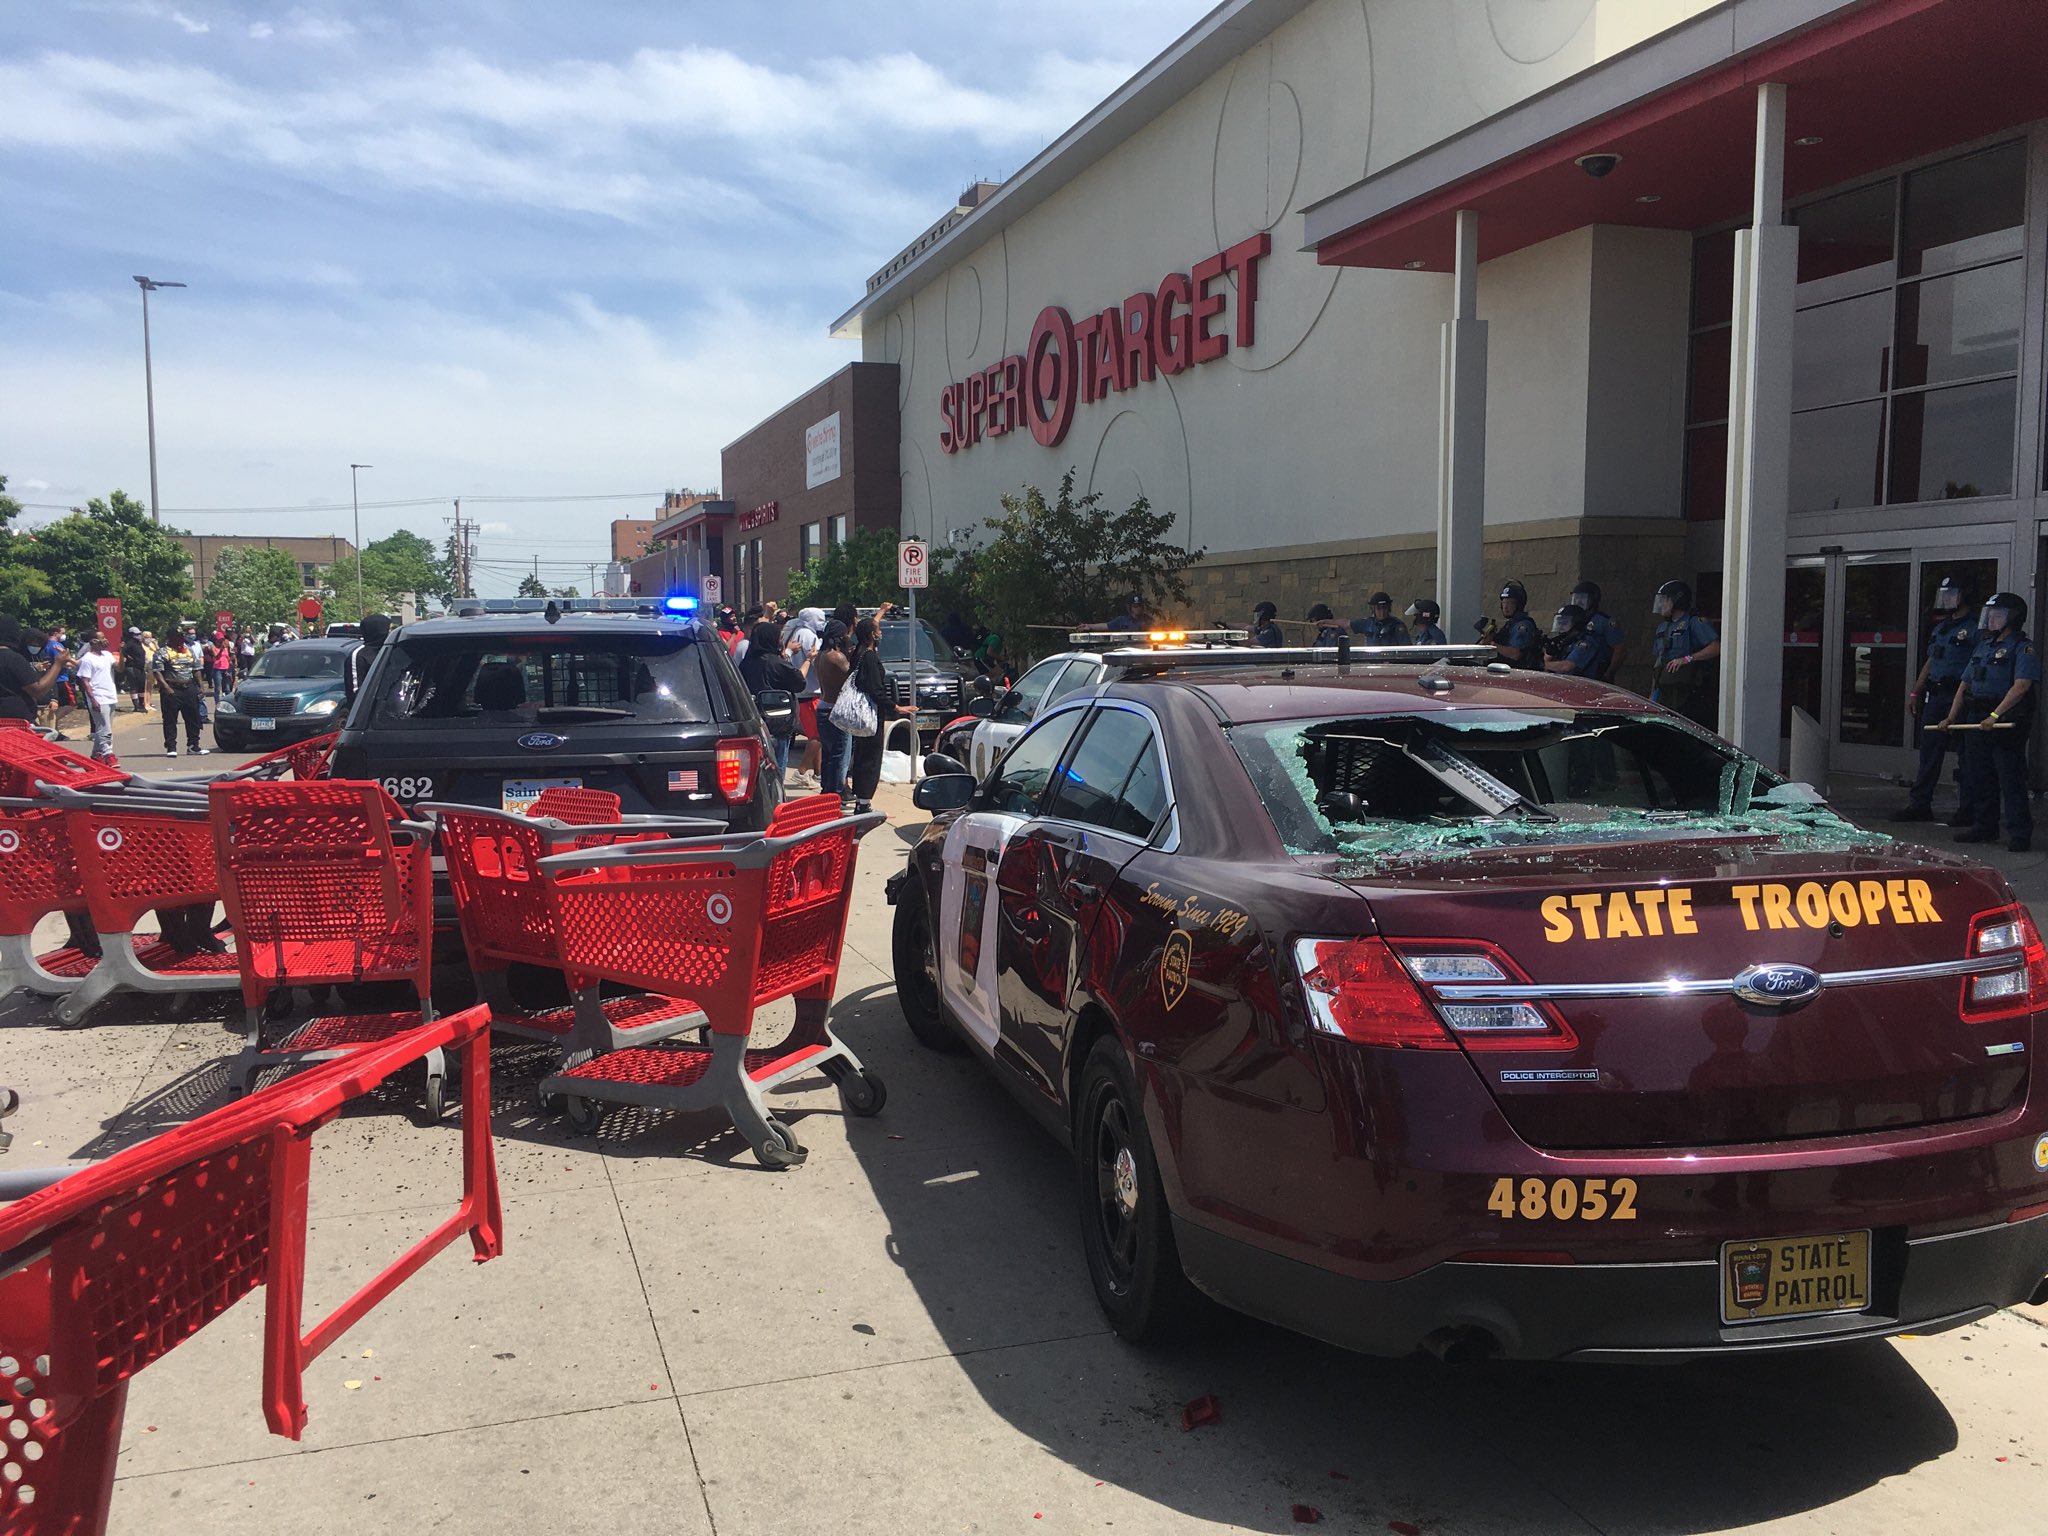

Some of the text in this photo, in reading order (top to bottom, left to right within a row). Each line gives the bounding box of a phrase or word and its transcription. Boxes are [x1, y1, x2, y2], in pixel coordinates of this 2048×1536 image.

[940, 232, 1272, 454] SUPER TARGET
[100, 605, 118, 614] EXIT
[528, 735, 553, 746] Ford
[377, 776, 434, 798] 682
[1140, 882, 1248, 937] Serving Since 1929
[1541, 879, 1942, 943] STATE TROOPER
[1765, 971, 1806, 992] Ford
[1536, 1072, 1596, 1080] INTERCEPTOR
[1487, 1177, 1638, 1221] 48052
[1733, 1253, 1767, 1262] MINNESOTA
[1781, 1241, 1850, 1272] STATE
[1775, 1274, 1863, 1307] PATROL
